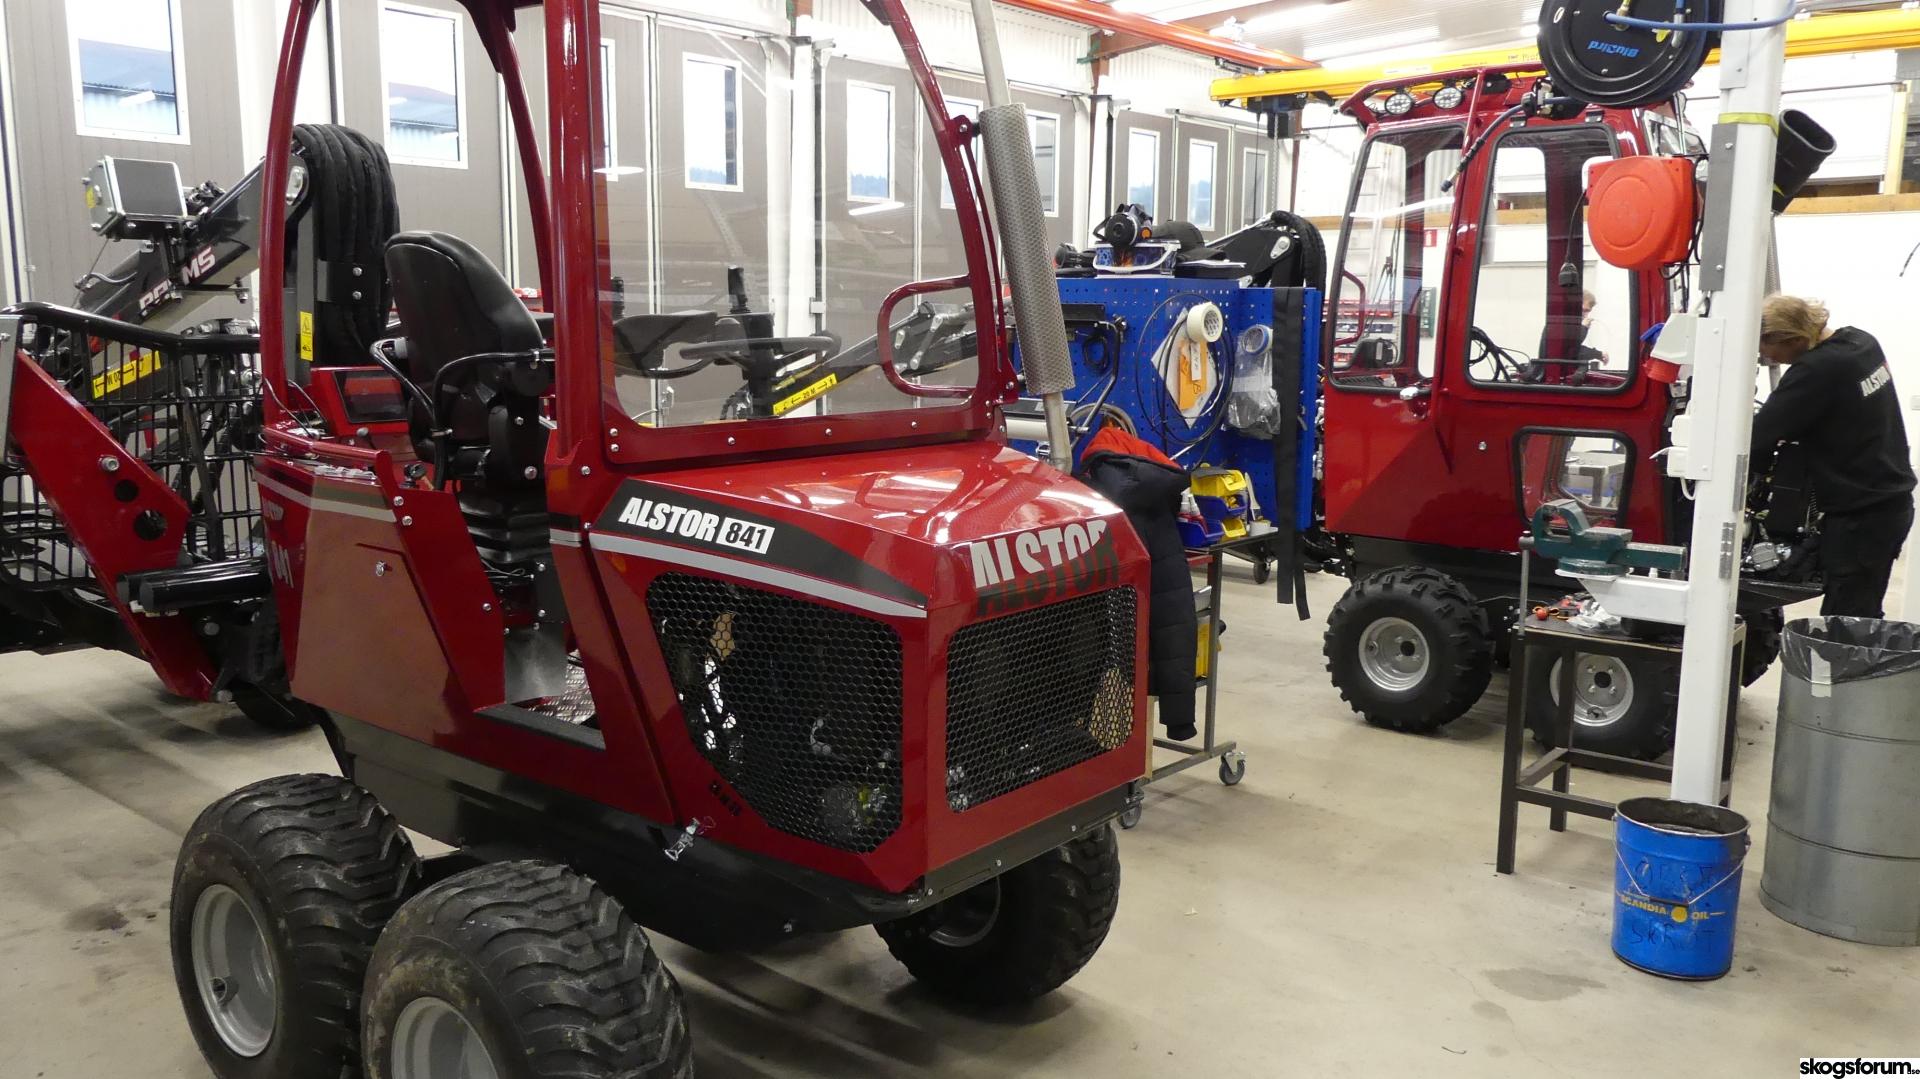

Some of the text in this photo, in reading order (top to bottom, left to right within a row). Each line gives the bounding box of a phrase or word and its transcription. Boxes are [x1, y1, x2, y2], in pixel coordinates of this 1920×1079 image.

[139, 246, 216, 317] PAMS
[618, 497, 767, 550] ALSTOR 841
[970, 519, 1120, 617] ALSTOR
[1692, 911, 1710, 921] OIL
